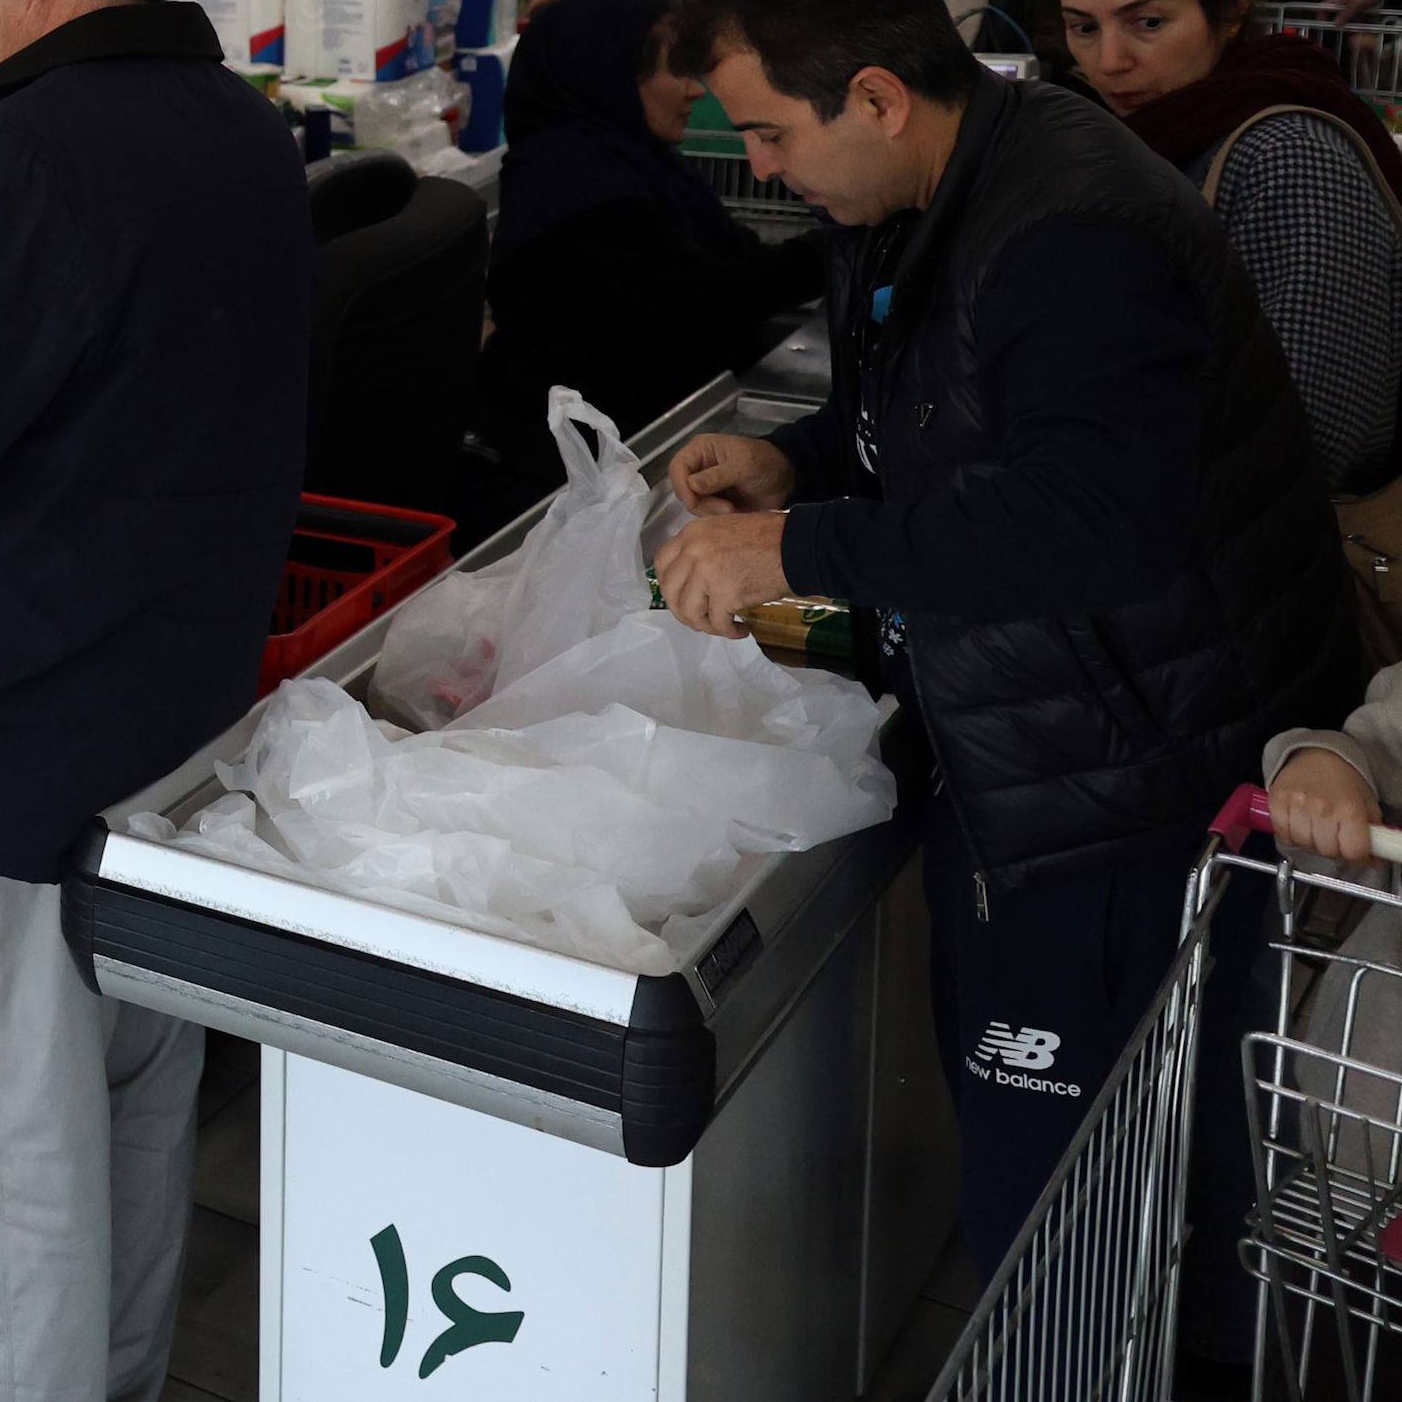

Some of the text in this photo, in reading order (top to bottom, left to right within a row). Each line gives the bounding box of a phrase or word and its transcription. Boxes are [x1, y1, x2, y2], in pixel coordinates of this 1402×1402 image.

[965, 1056, 1082, 1097] new balance
[369, 1223, 525, 1379] ۱۶
